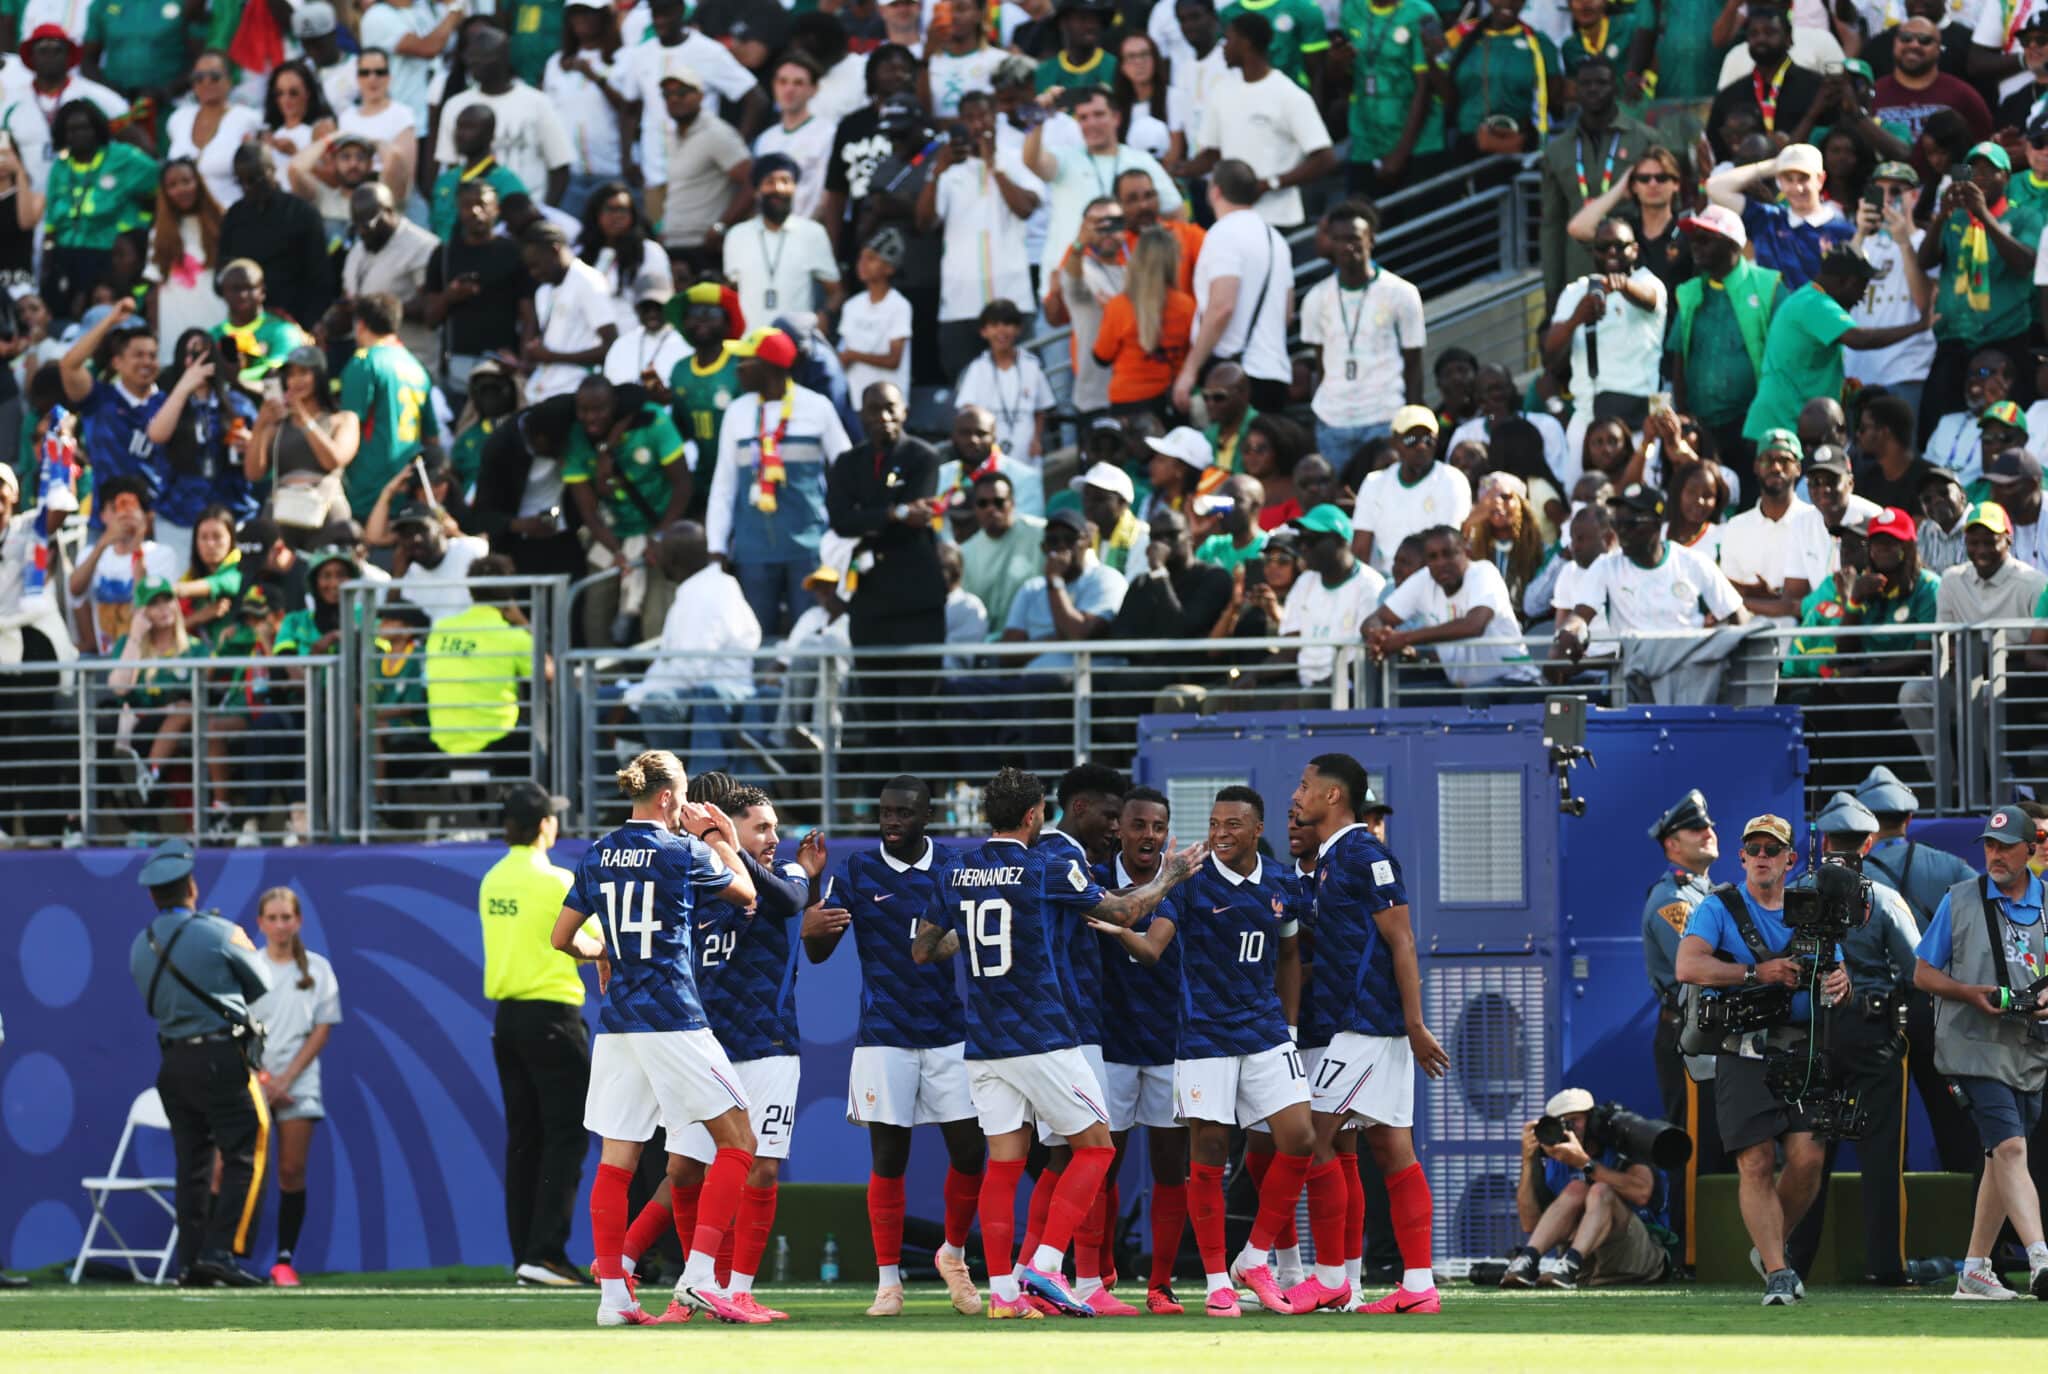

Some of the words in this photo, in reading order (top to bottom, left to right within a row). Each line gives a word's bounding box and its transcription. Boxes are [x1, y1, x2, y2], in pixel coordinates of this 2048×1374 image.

[439, 635, 477, 657] 182
[600, 848, 657, 868] RABIOT
[952, 866, 1024, 888] T.HERNANDEZ
[488, 898, 519, 916] 255
[599, 881, 663, 960] 14
[702, 930, 736, 966] 24
[960, 898, 1013, 978] 19
[1238, 930, 1264, 963] 10
[1282, 1051, 1307, 1080] 10
[1314, 1057, 1347, 1089] 17
[761, 1104, 794, 1136] 24
